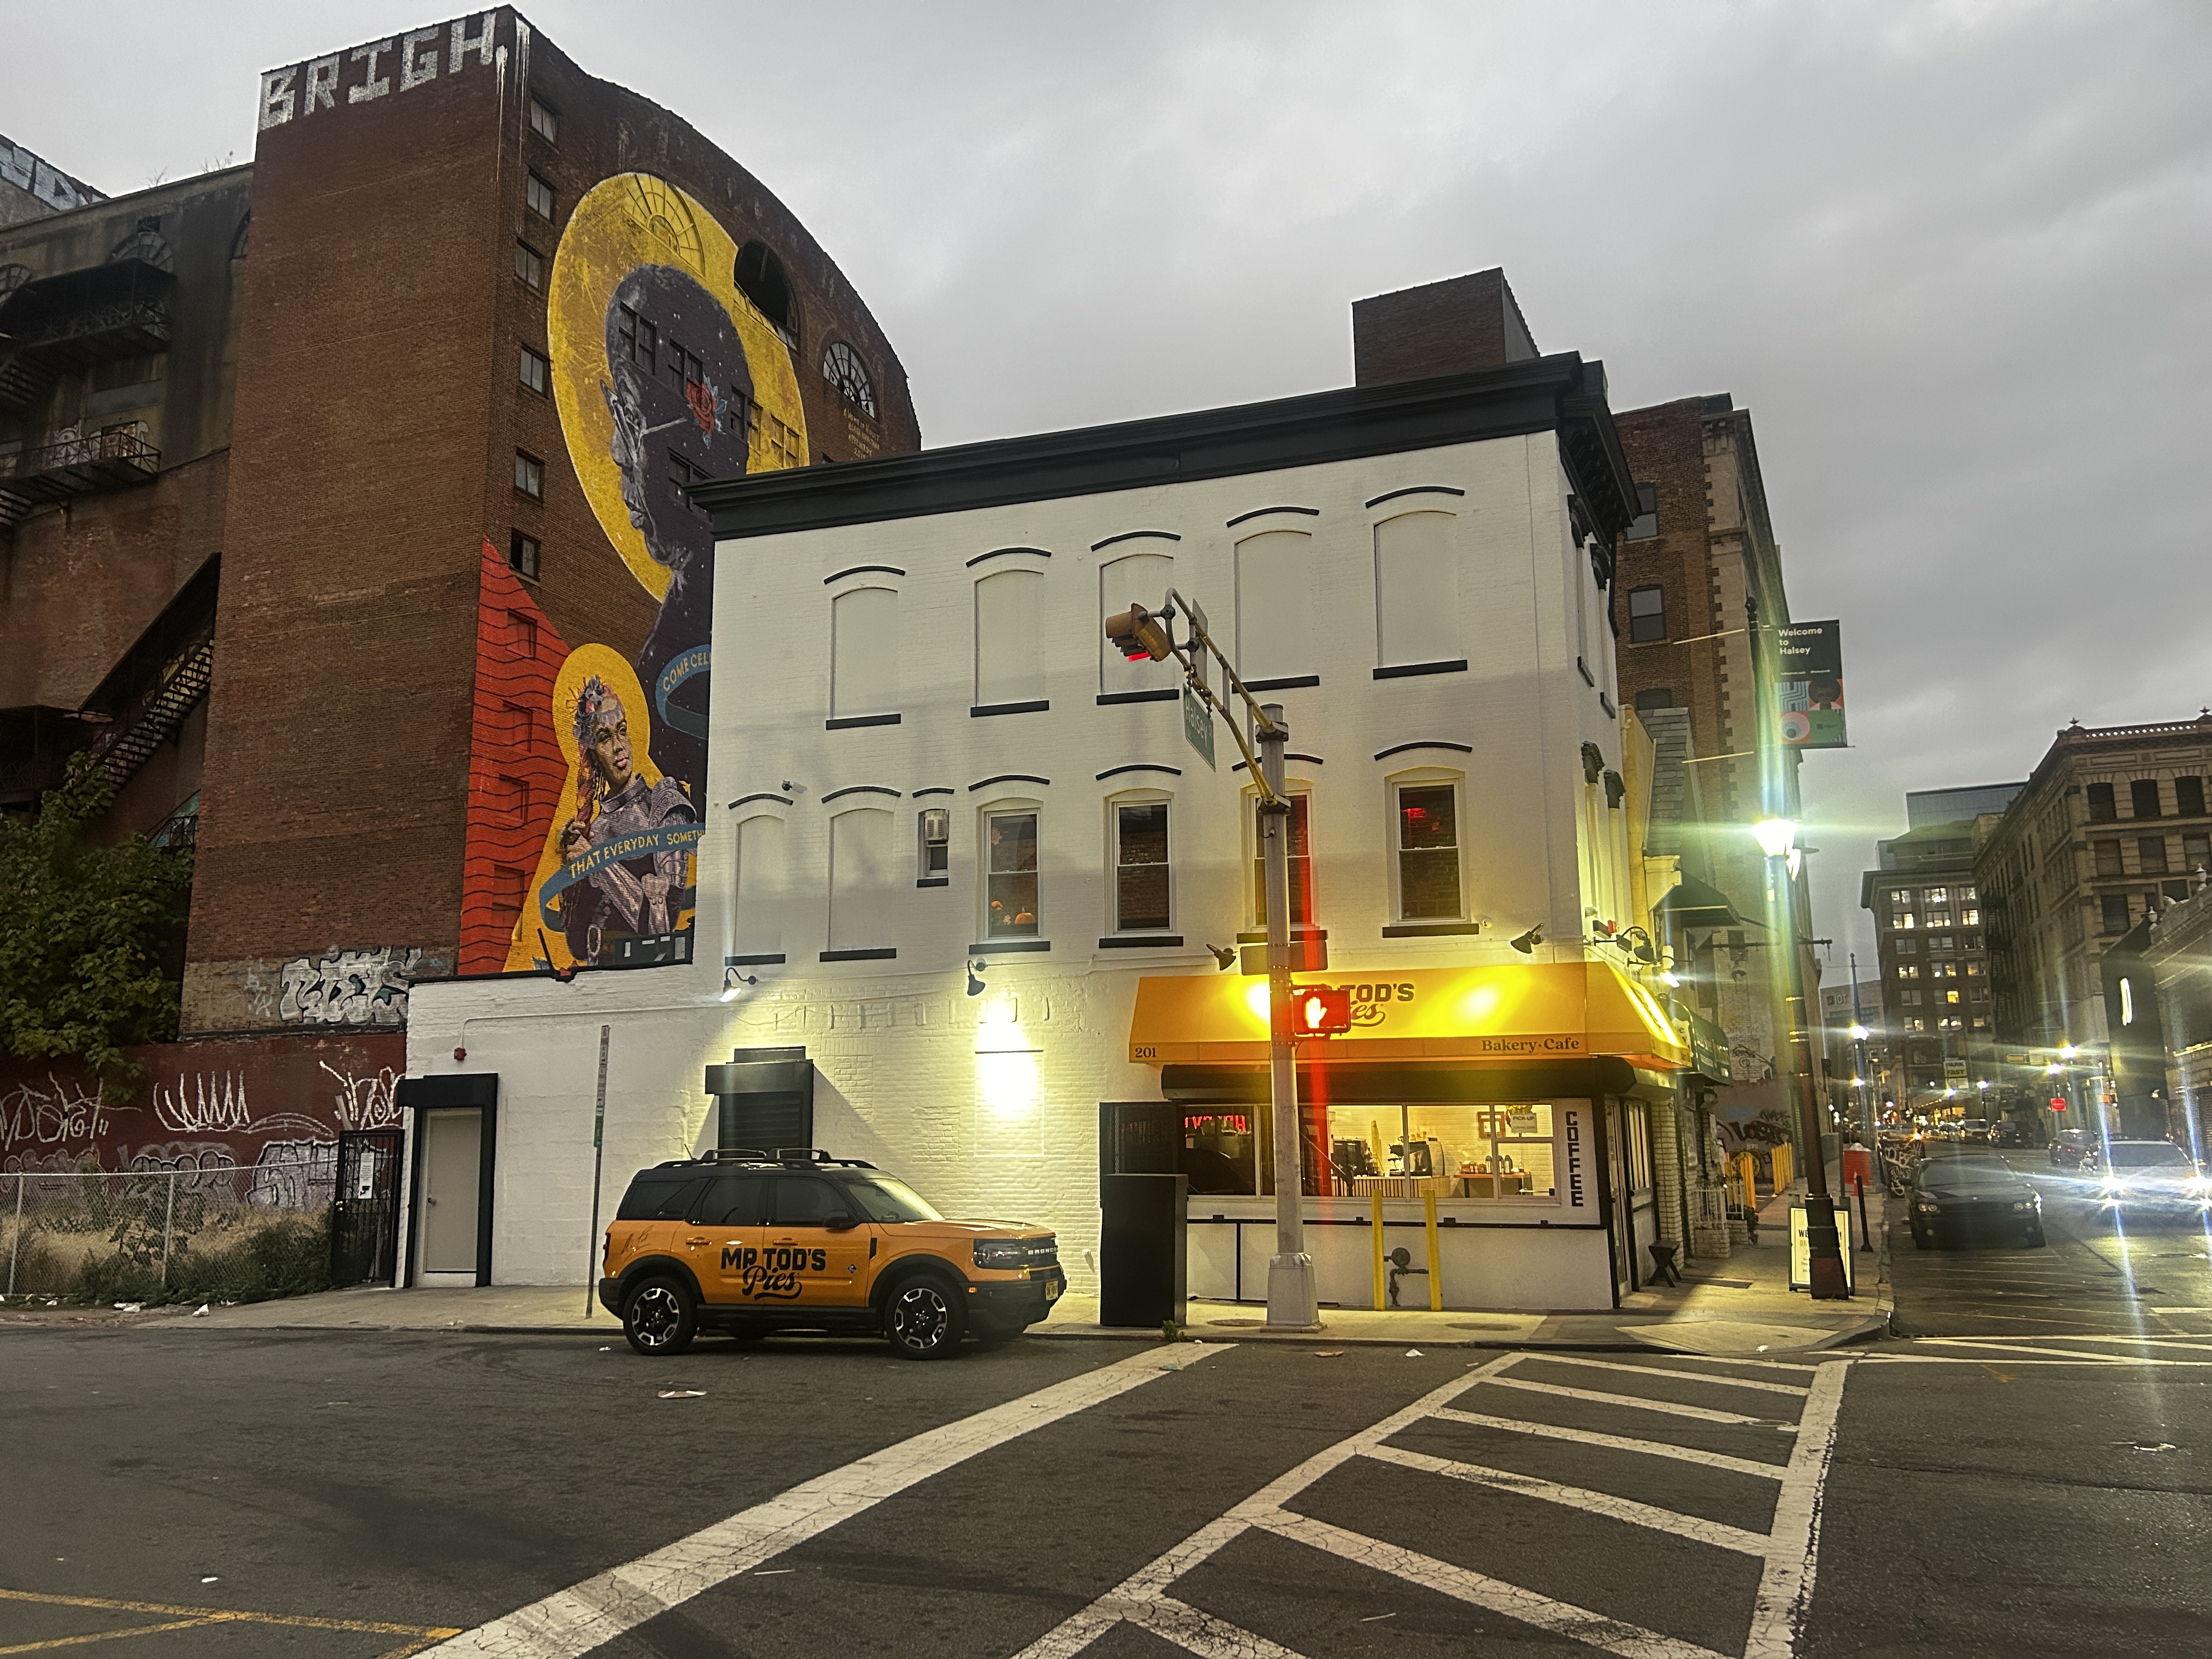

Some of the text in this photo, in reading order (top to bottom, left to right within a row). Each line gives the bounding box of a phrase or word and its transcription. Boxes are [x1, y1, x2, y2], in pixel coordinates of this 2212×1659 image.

[1779, 628, 1822, 636] Welcome
[1780, 647, 1810, 655] Halsey
[663, 657, 689, 691] COME
[1185, 693, 1207, 750] Halsey
[568, 850, 600, 879] THAT
[604, 834, 659, 860] EVERYDAY
[1350, 1000, 1386, 1026] ies
[1135, 1047, 1156, 1058] 201
[1566, 1111, 1584, 1207] COFFEE
[721, 1248, 826, 1271] MR TOD'S
[742, 1265, 803, 1301] Pies
